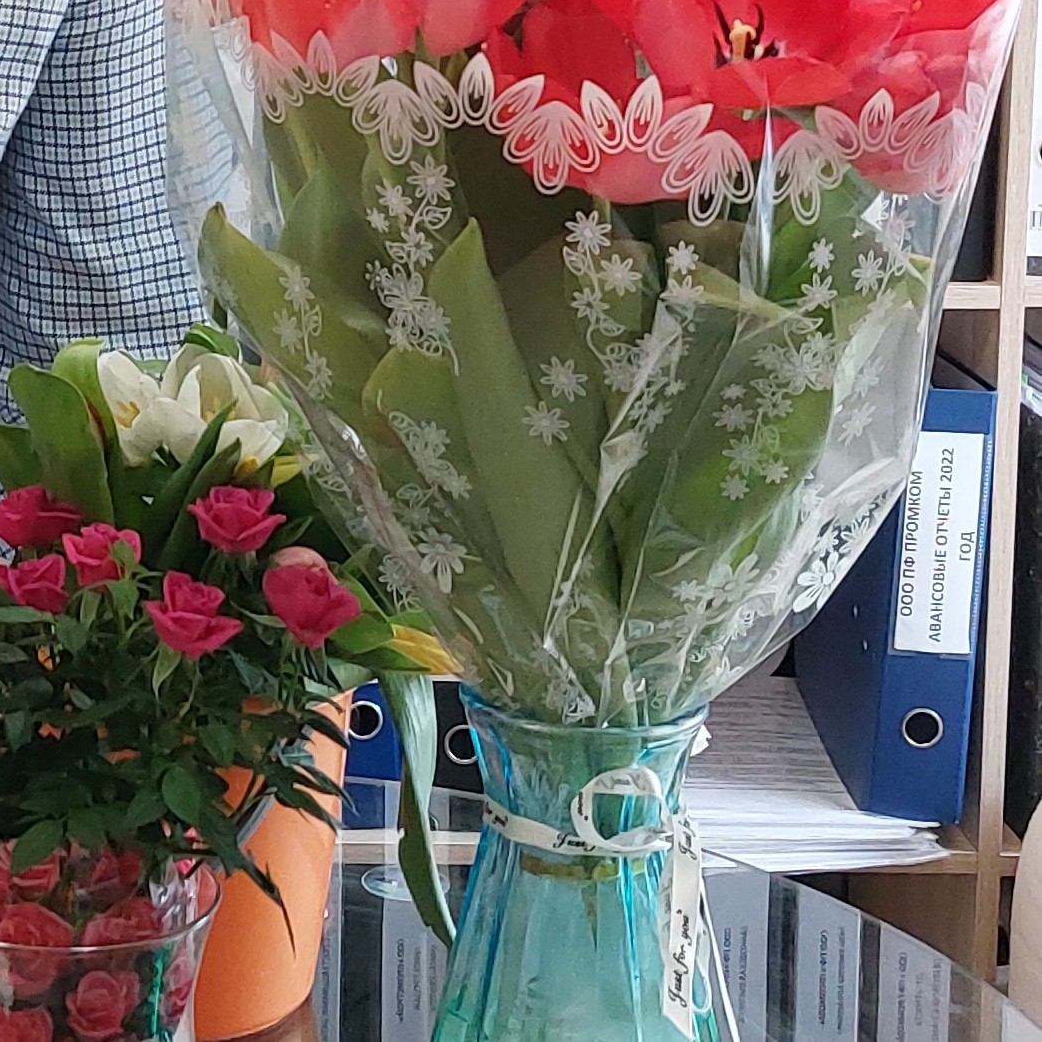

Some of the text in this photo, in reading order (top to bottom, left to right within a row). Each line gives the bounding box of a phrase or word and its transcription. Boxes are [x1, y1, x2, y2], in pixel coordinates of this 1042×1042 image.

[899, 470, 923, 617] ООО ПФ ПРОМКОМ
[928, 447, 955, 643] АВАНСОВЫЕ ОТЧЕТЫ 2022
[958, 531, 976, 562] ГОД
[672, 944, 689, 975] for
[667, 969, 688, 1008] Just
